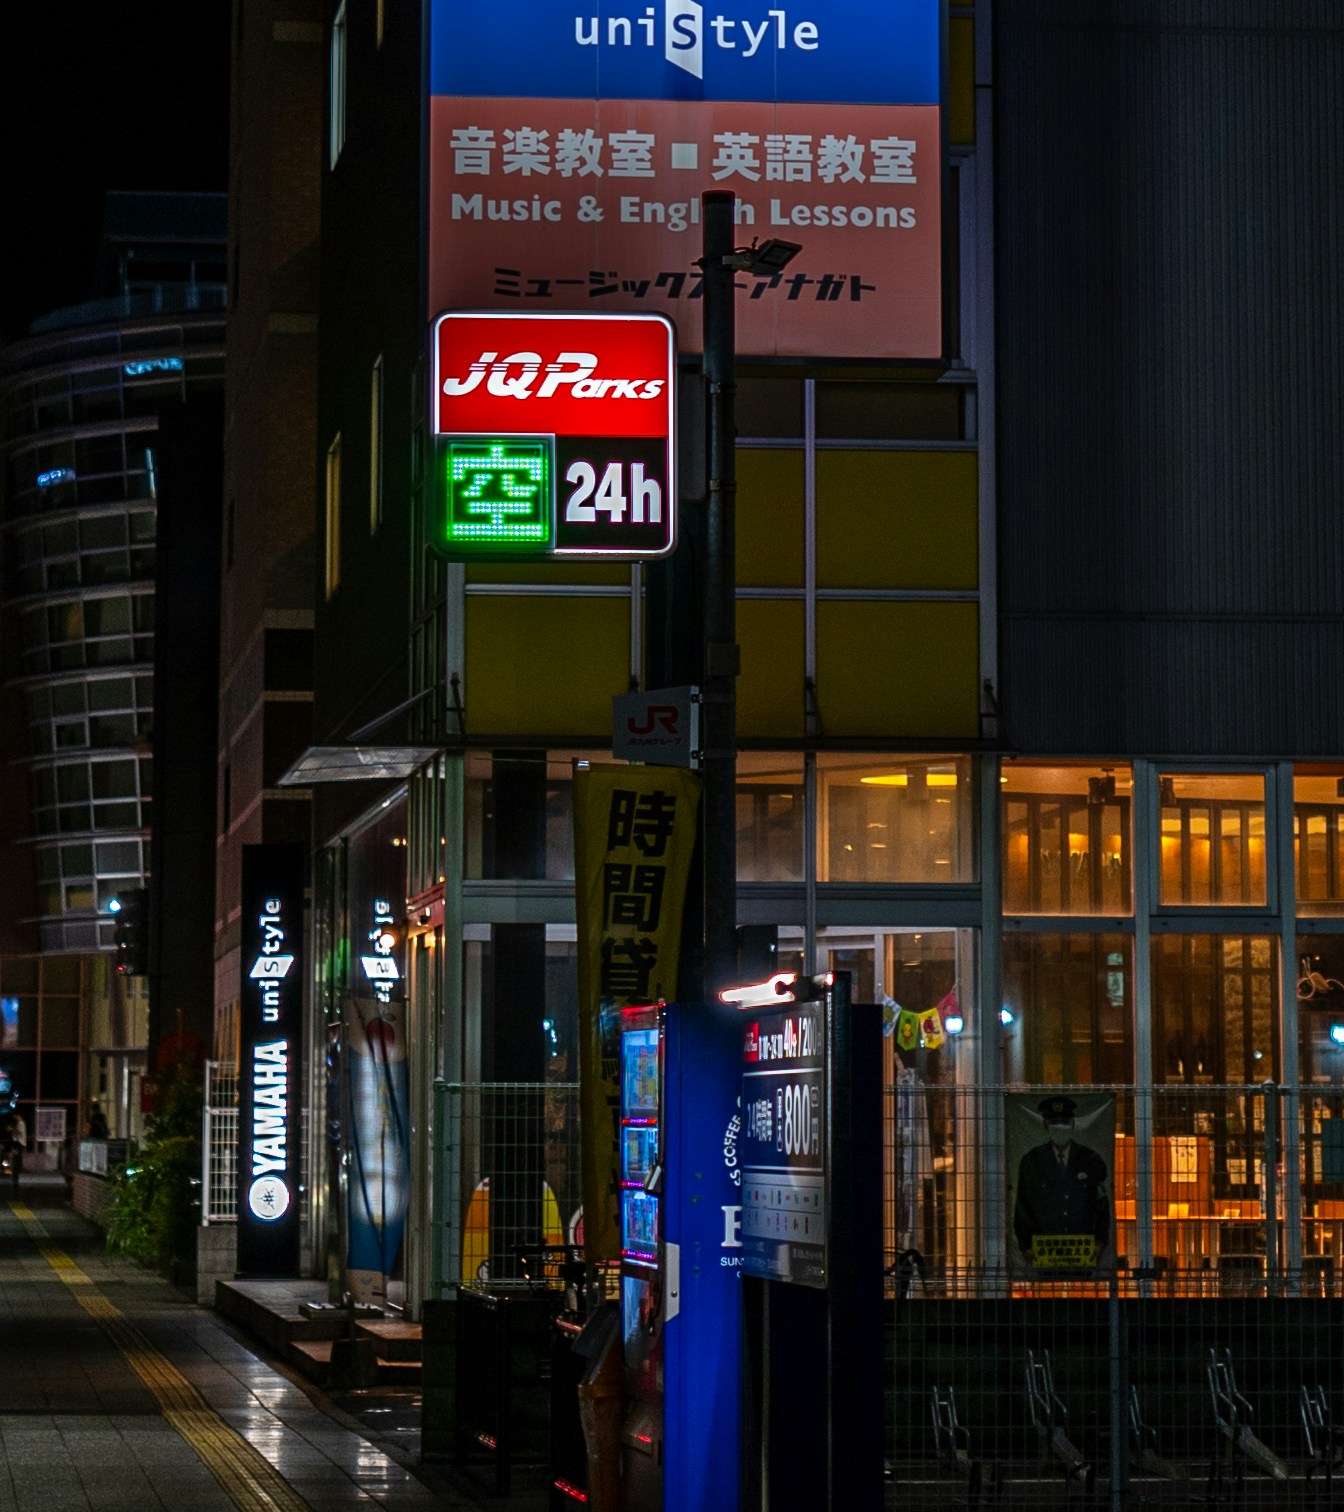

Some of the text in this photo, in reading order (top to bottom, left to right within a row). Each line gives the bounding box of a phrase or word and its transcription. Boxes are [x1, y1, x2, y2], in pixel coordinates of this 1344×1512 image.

[449, 126, 918, 185] 音楽教室 英語教室
[450, 193, 917, 232] Music & Englh Lessons
[451, 444, 543, 538] 空
[564, 460, 663, 524] 24h
[628, 706, 678, 734] JR
[254, 897, 289, 1023] uniStyle
[253, 1038, 289, 1178] YAMAHA
